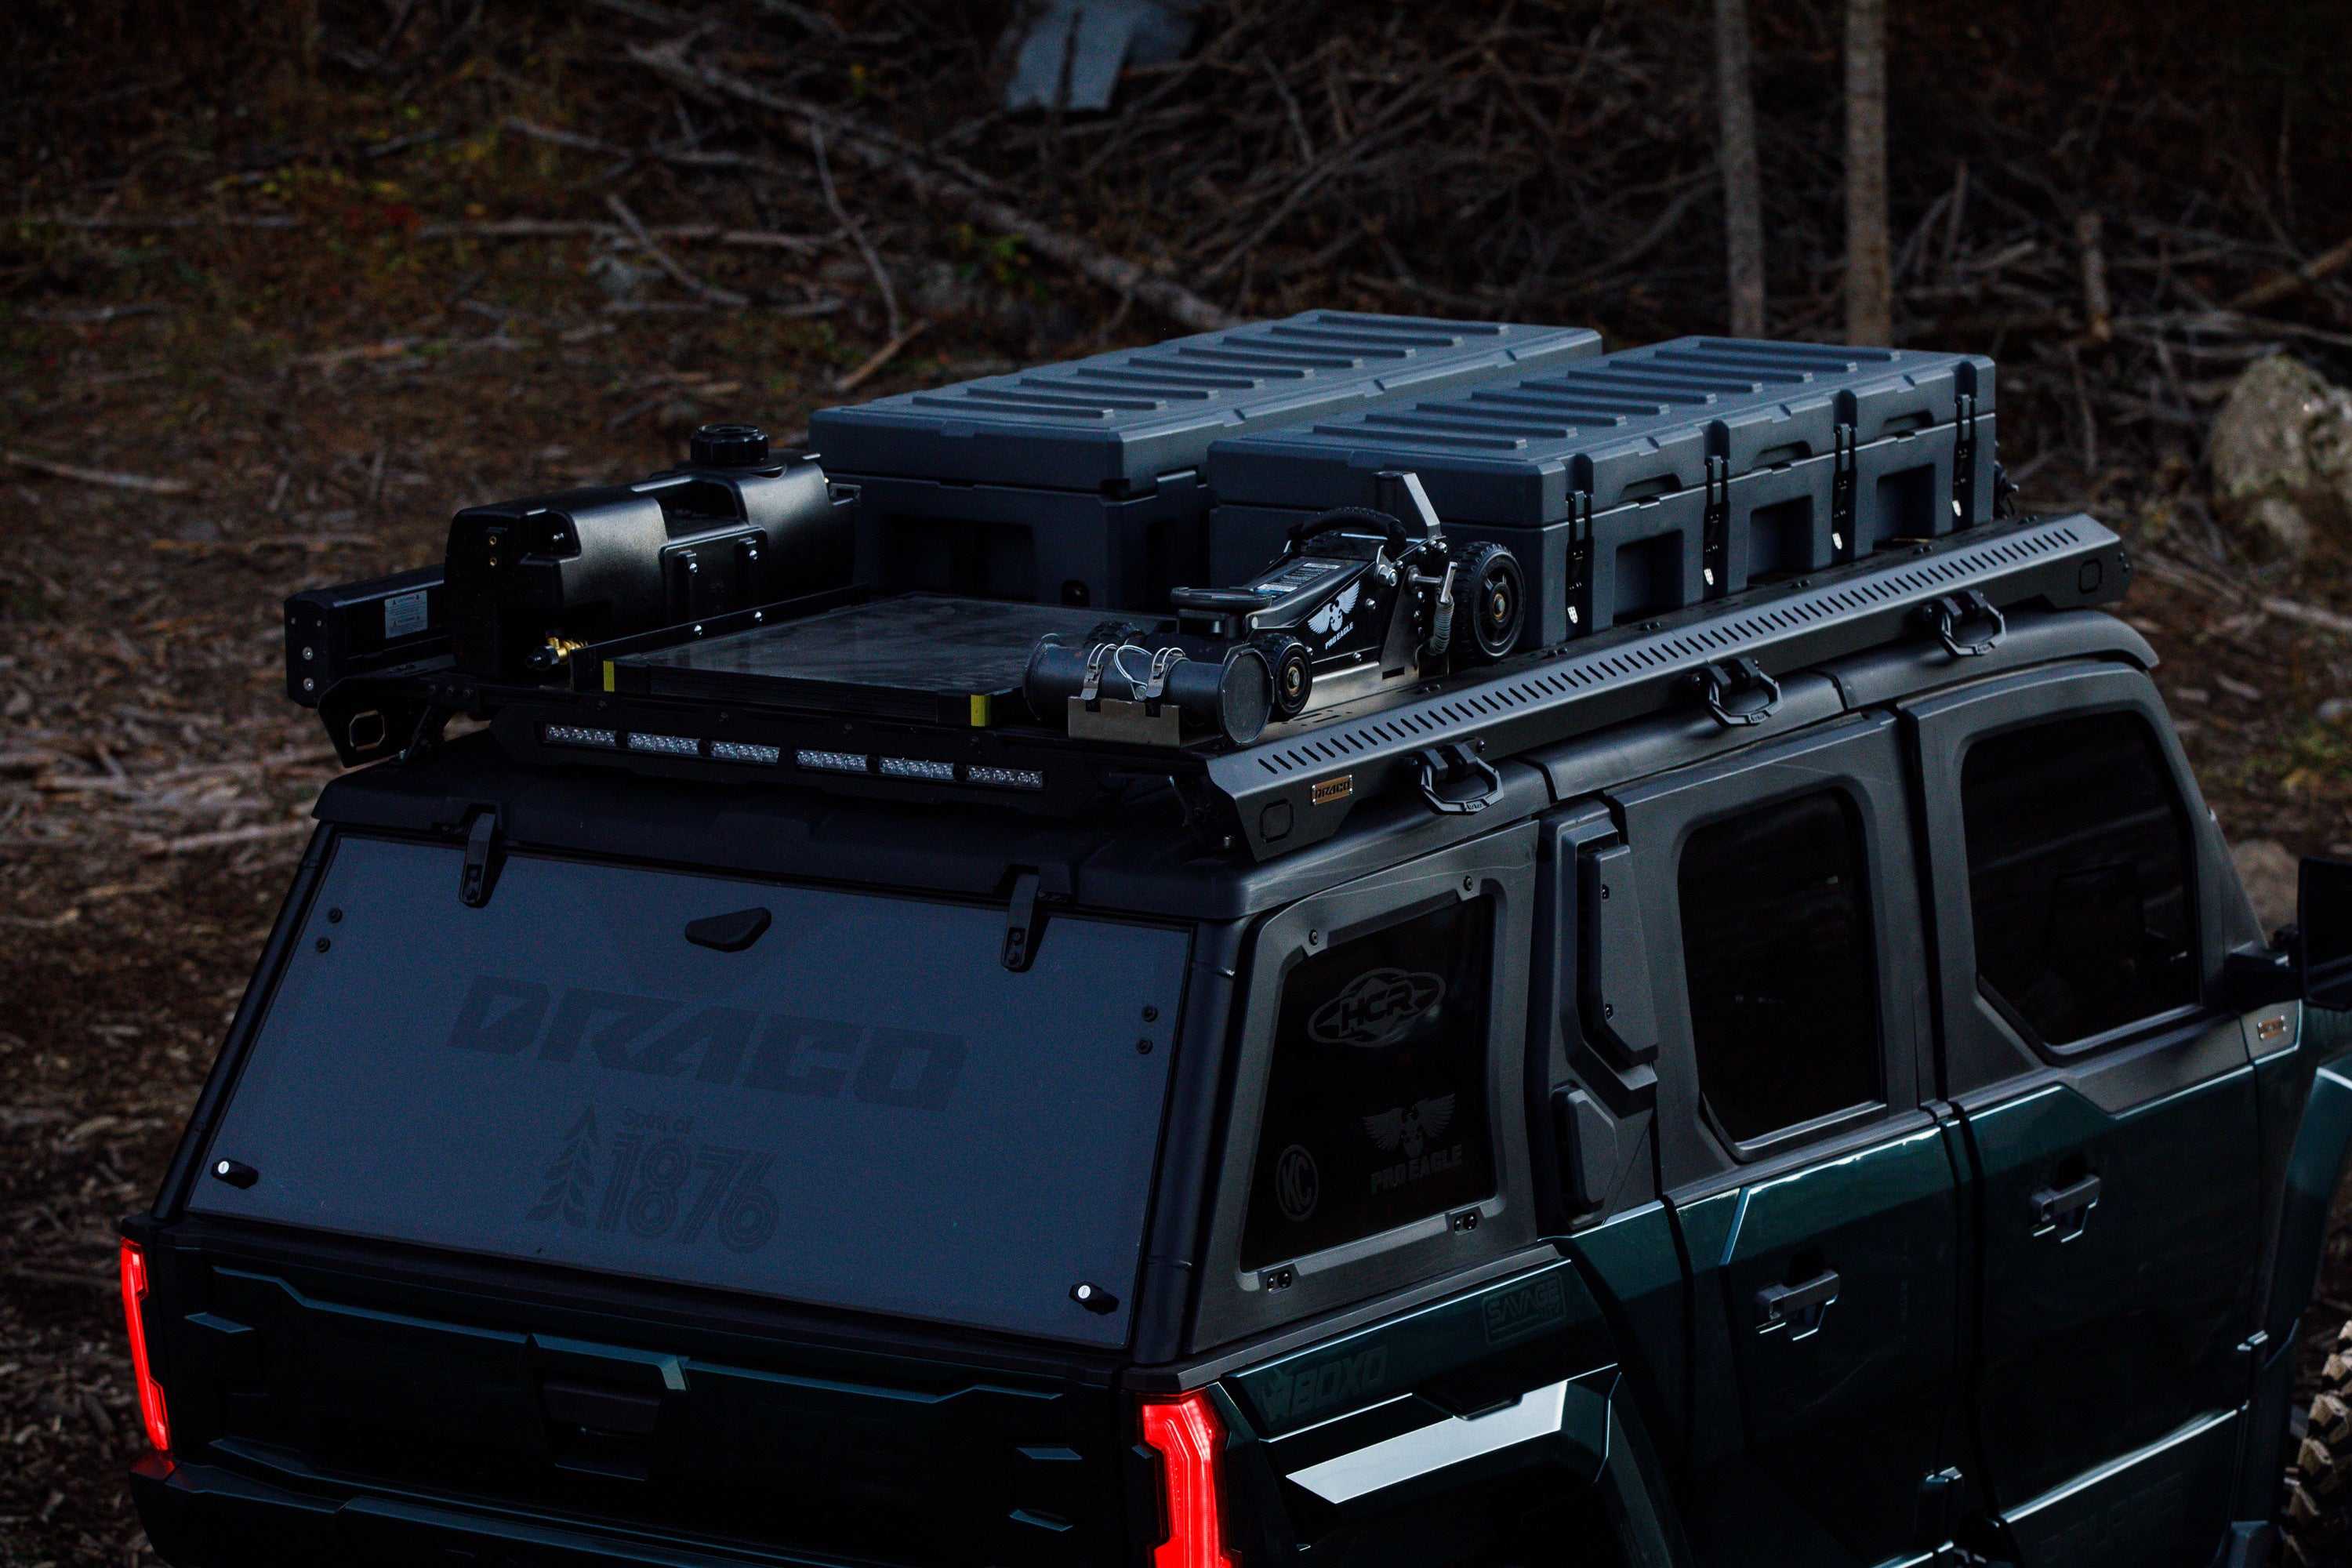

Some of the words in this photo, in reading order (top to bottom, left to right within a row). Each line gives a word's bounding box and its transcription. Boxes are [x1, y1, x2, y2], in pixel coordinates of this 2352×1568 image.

[1325, 635, 1337, 650] PRO
[1337, 621, 1354, 641] EAGLE
[1340, 983, 1416, 1033] HCR
[448, 975, 967, 1112] DRACO
[596, 1131, 781, 1254] 1876
[1281, 1153, 1312, 1210] KC
[1370, 1163, 1407, 1195] PRO
[1408, 1143, 1464, 1181] EAGLE
[1486, 1279, 1560, 1327] SAVAGE
